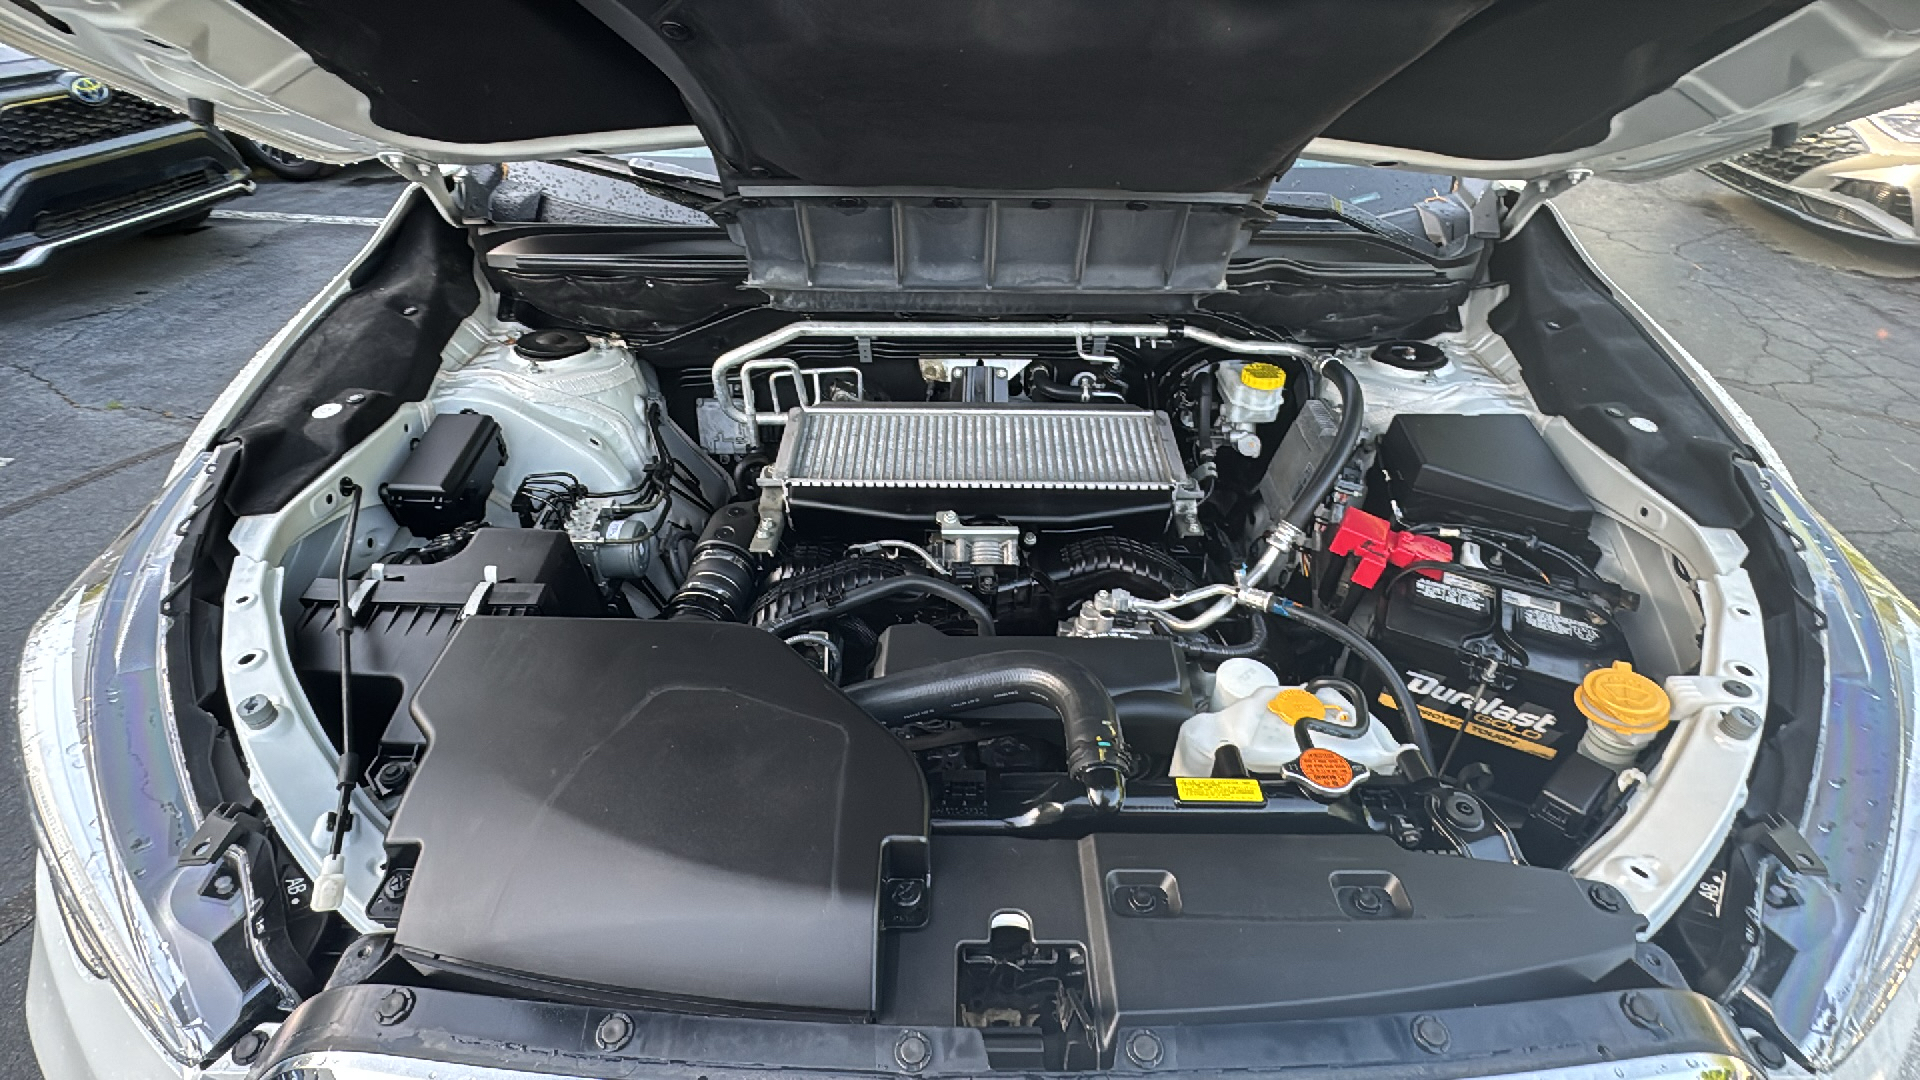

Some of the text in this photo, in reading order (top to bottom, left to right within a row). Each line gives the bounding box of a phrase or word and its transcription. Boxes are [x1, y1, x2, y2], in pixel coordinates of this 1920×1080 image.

[1406, 670, 1557, 733] Duralast
[1471, 726, 1518, 745] TOUGH
[1473, 713, 1542, 741] GOLD
[285, 877, 307, 895] AB
